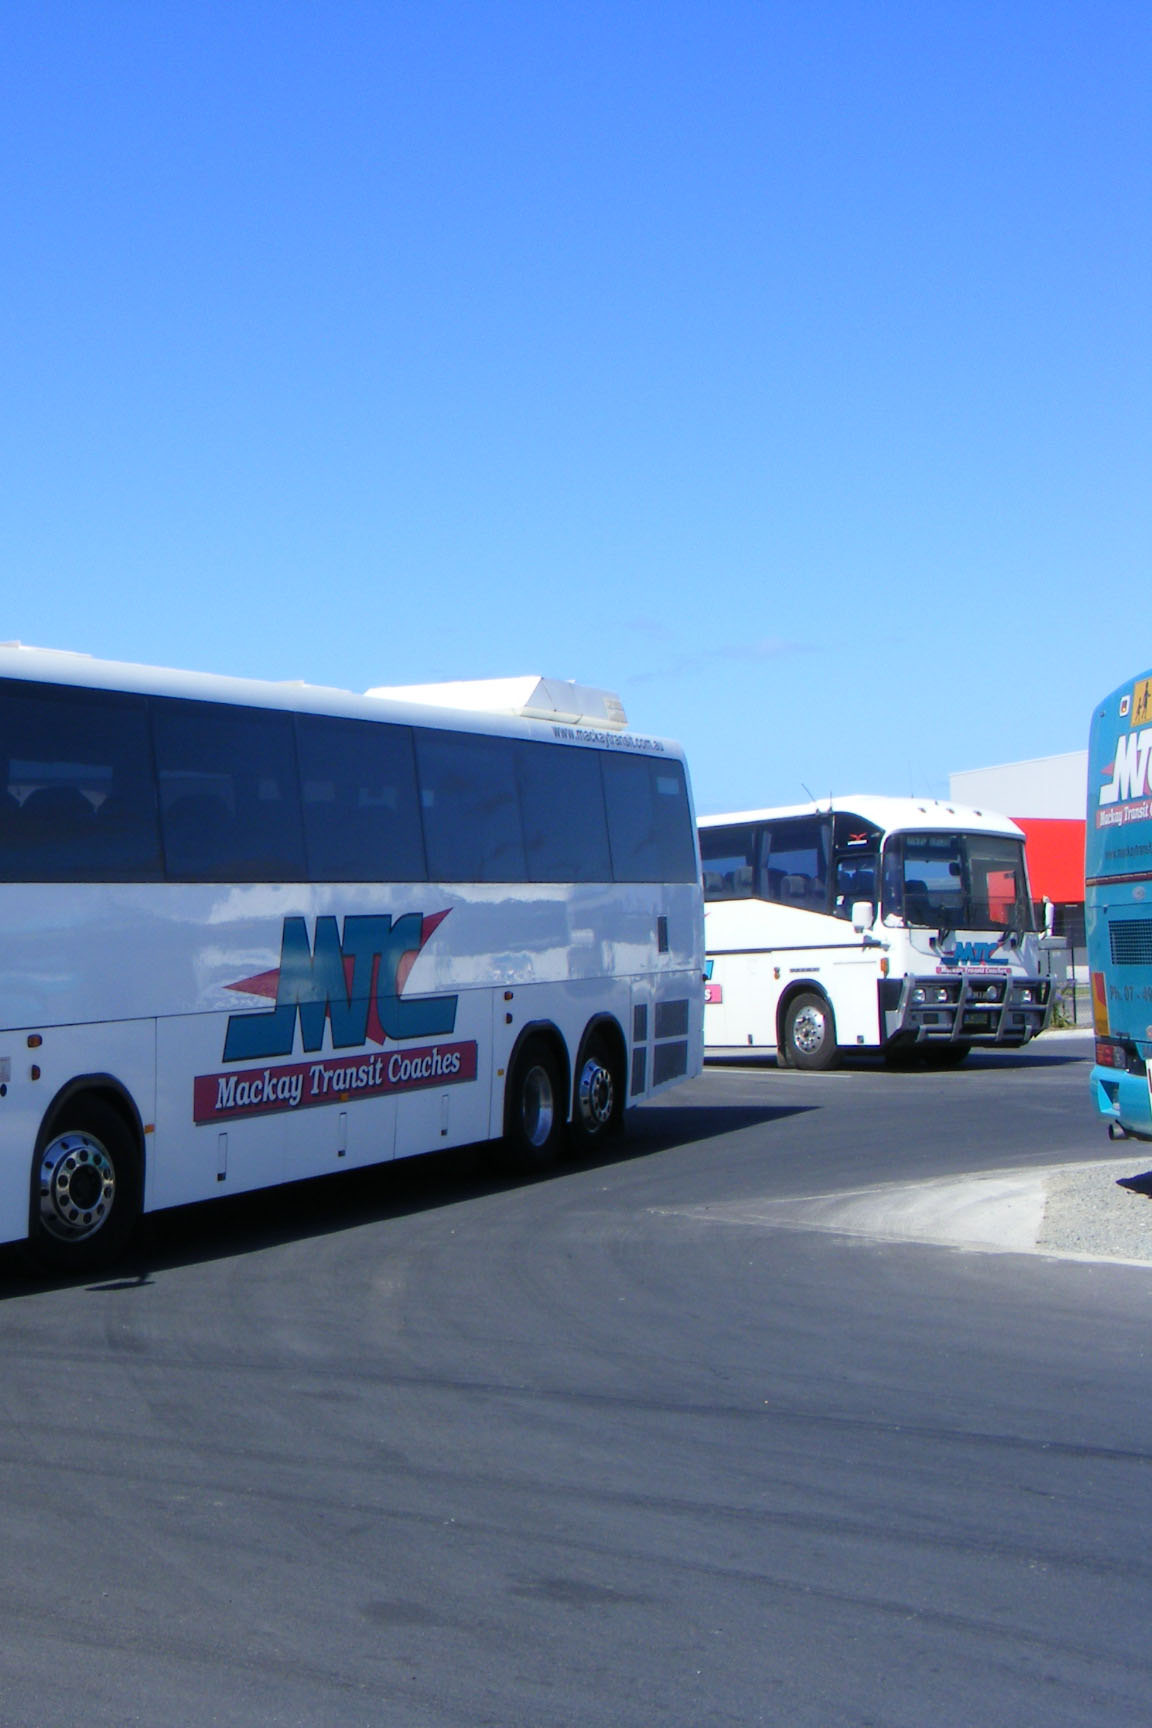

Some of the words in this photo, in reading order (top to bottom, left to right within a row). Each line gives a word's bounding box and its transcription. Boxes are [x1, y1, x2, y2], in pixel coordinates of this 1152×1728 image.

[1099, 727, 1152, 806] MT
[1124, 800, 1149, 821] Transit
[940, 941, 1009, 966] MTC
[222, 912, 459, 1063] MTC
[215, 1070, 304, 1110] Mackay
[309, 1055, 383, 1096] Transit
[387, 1047, 461, 1084] Coaches
